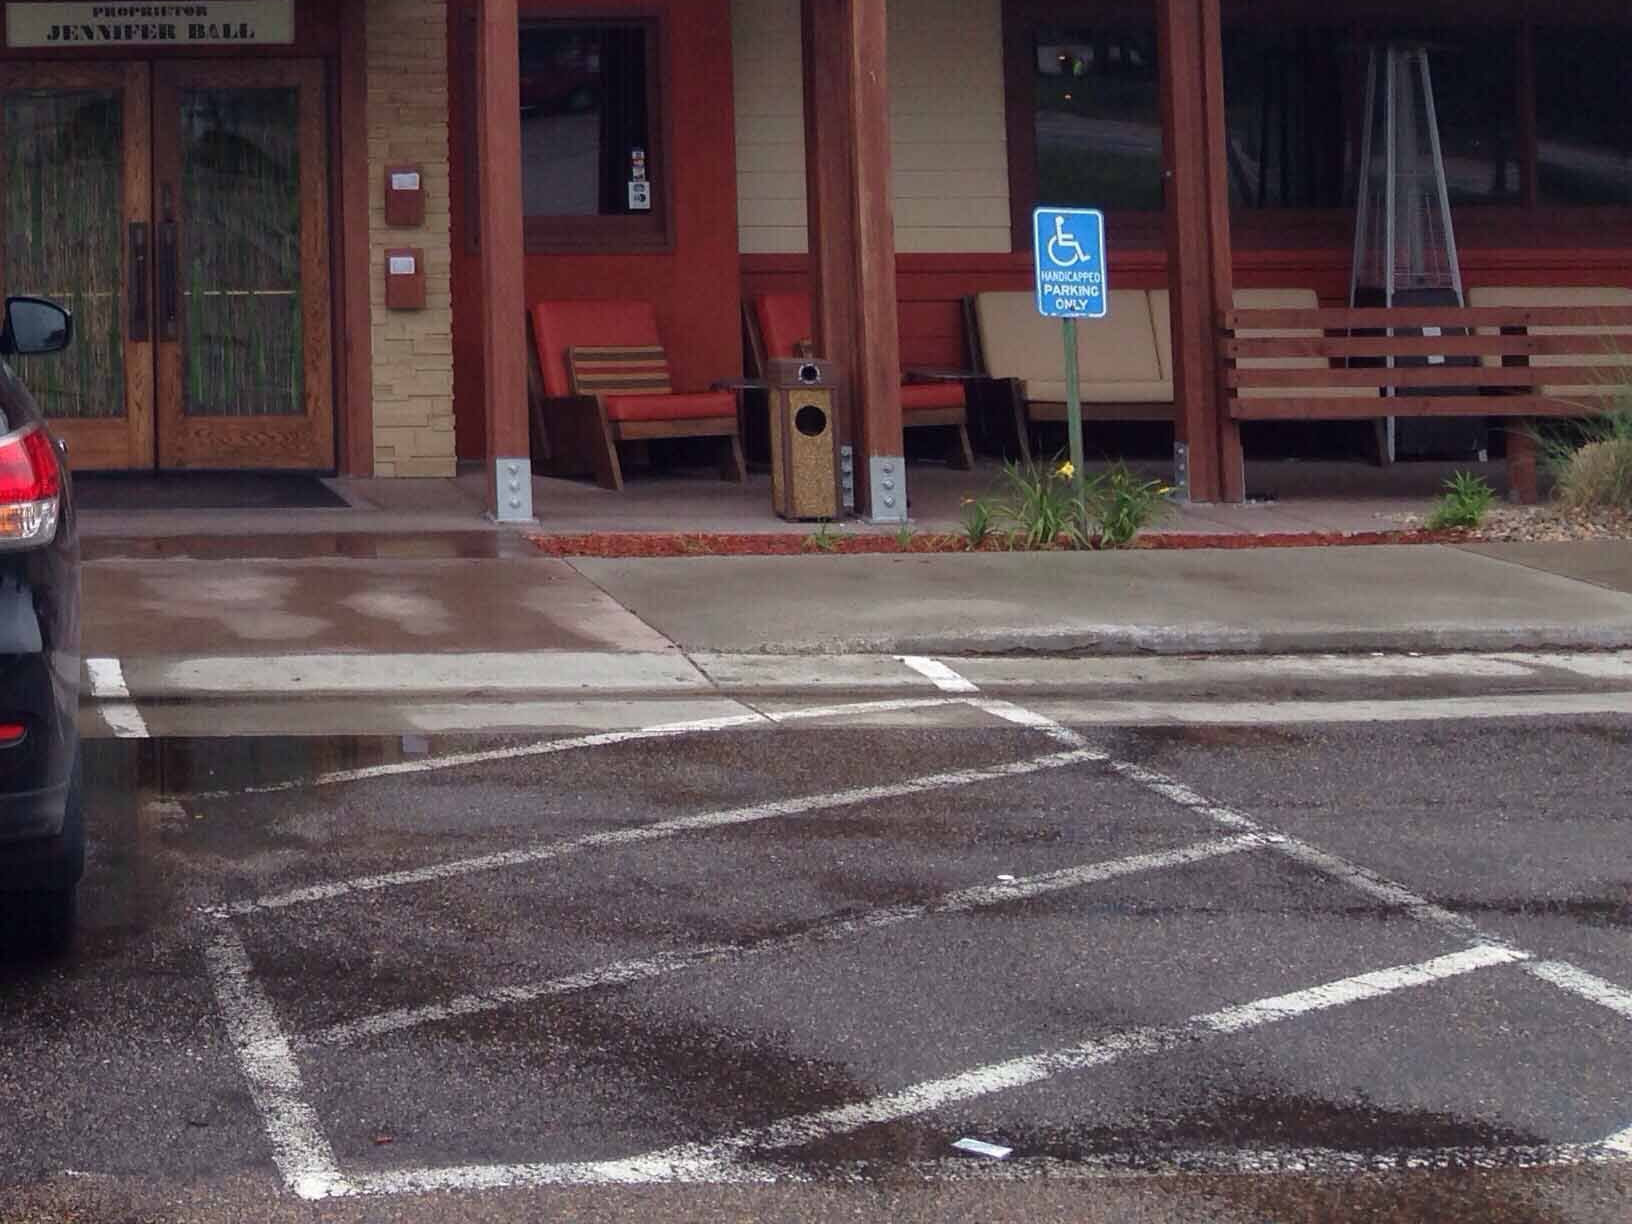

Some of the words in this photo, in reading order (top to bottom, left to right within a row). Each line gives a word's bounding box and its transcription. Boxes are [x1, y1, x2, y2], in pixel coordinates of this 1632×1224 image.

[92, 6, 208, 17] PROPRIETOR
[46, 24, 176, 40] JENNIFER
[187, 23, 256, 40] BALL
[1041, 271, 1101, 283] HANDICAPPED
[1044, 284, 1099, 297] PARKING
[1055, 298, 1088, 310] ONLY
